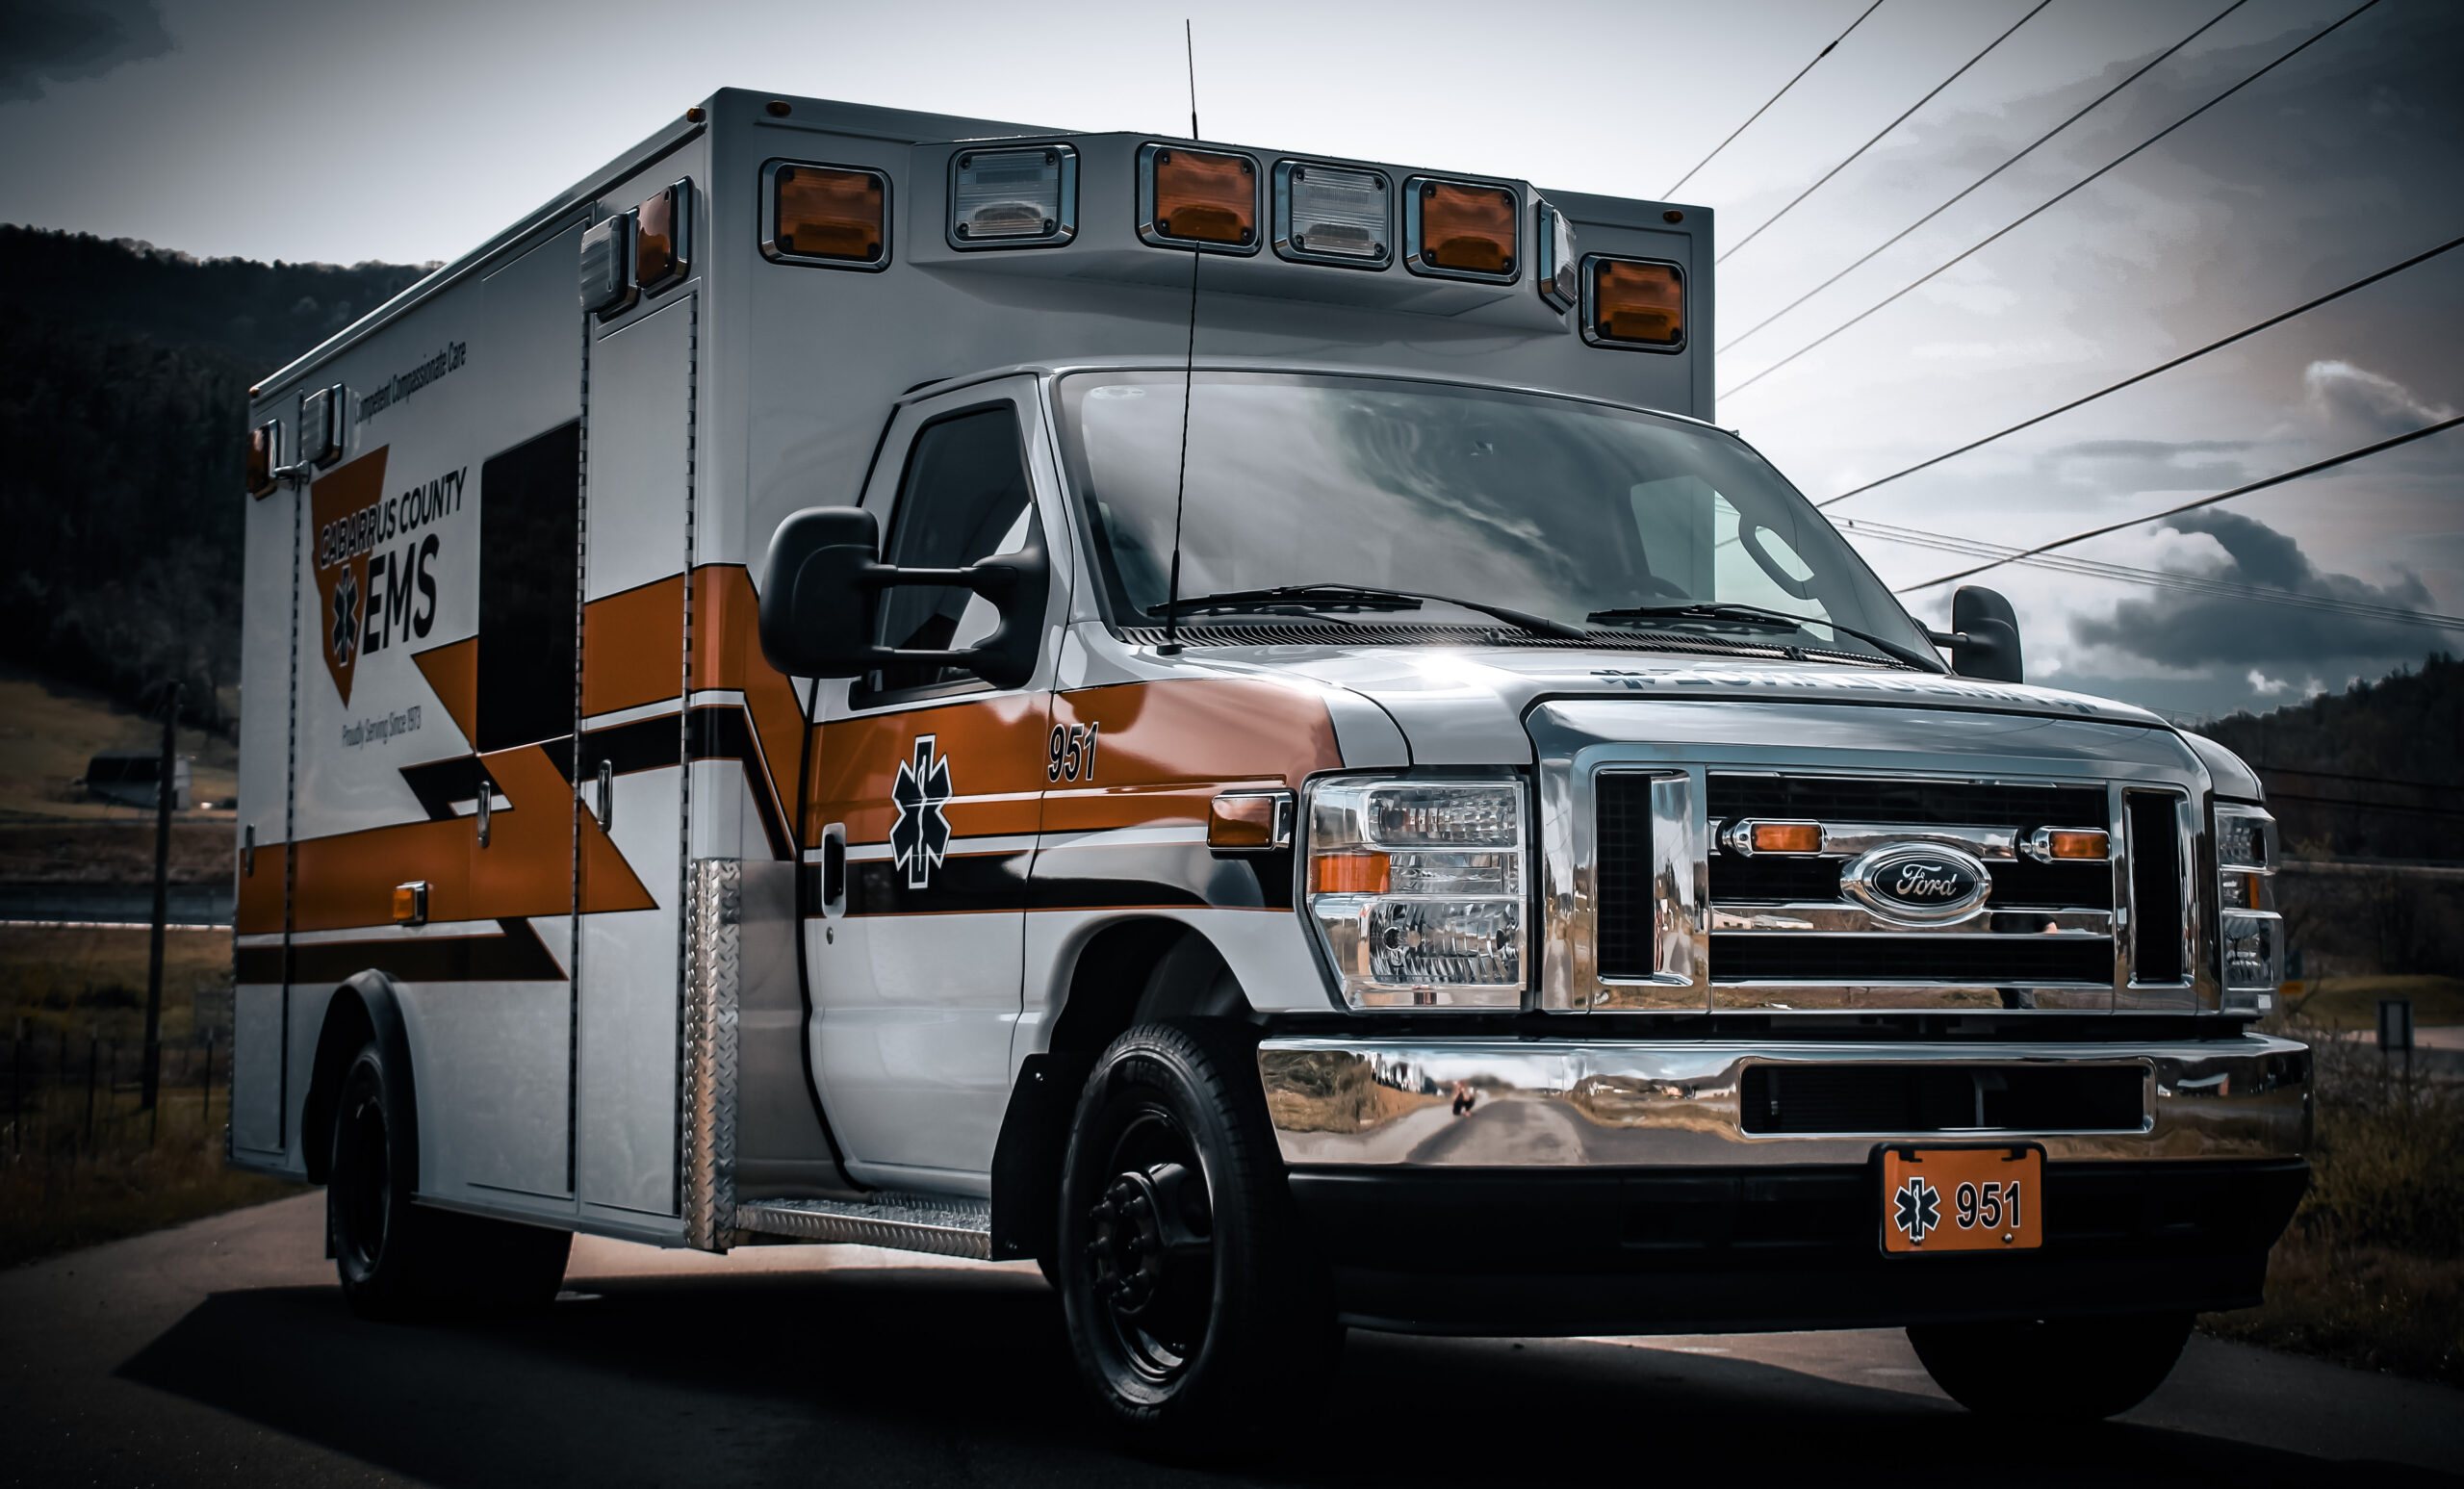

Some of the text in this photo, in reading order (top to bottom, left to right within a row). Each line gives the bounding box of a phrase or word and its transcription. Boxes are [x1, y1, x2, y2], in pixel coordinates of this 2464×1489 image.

[392, 348, 448, 404] Compassionate
[448, 341, 467, 372] Care
[319, 466, 468, 570] CABARRUS COUNTY
[362, 532, 440, 655] EMS
[342, 720, 365, 751] Proudly
[365, 717, 389, 745] Serving
[389, 711, 406, 737] Since
[1047, 721, 1099, 783] 951
[1896, 863, 1958, 896] Ford
[1955, 1180, 2020, 1230] 951
